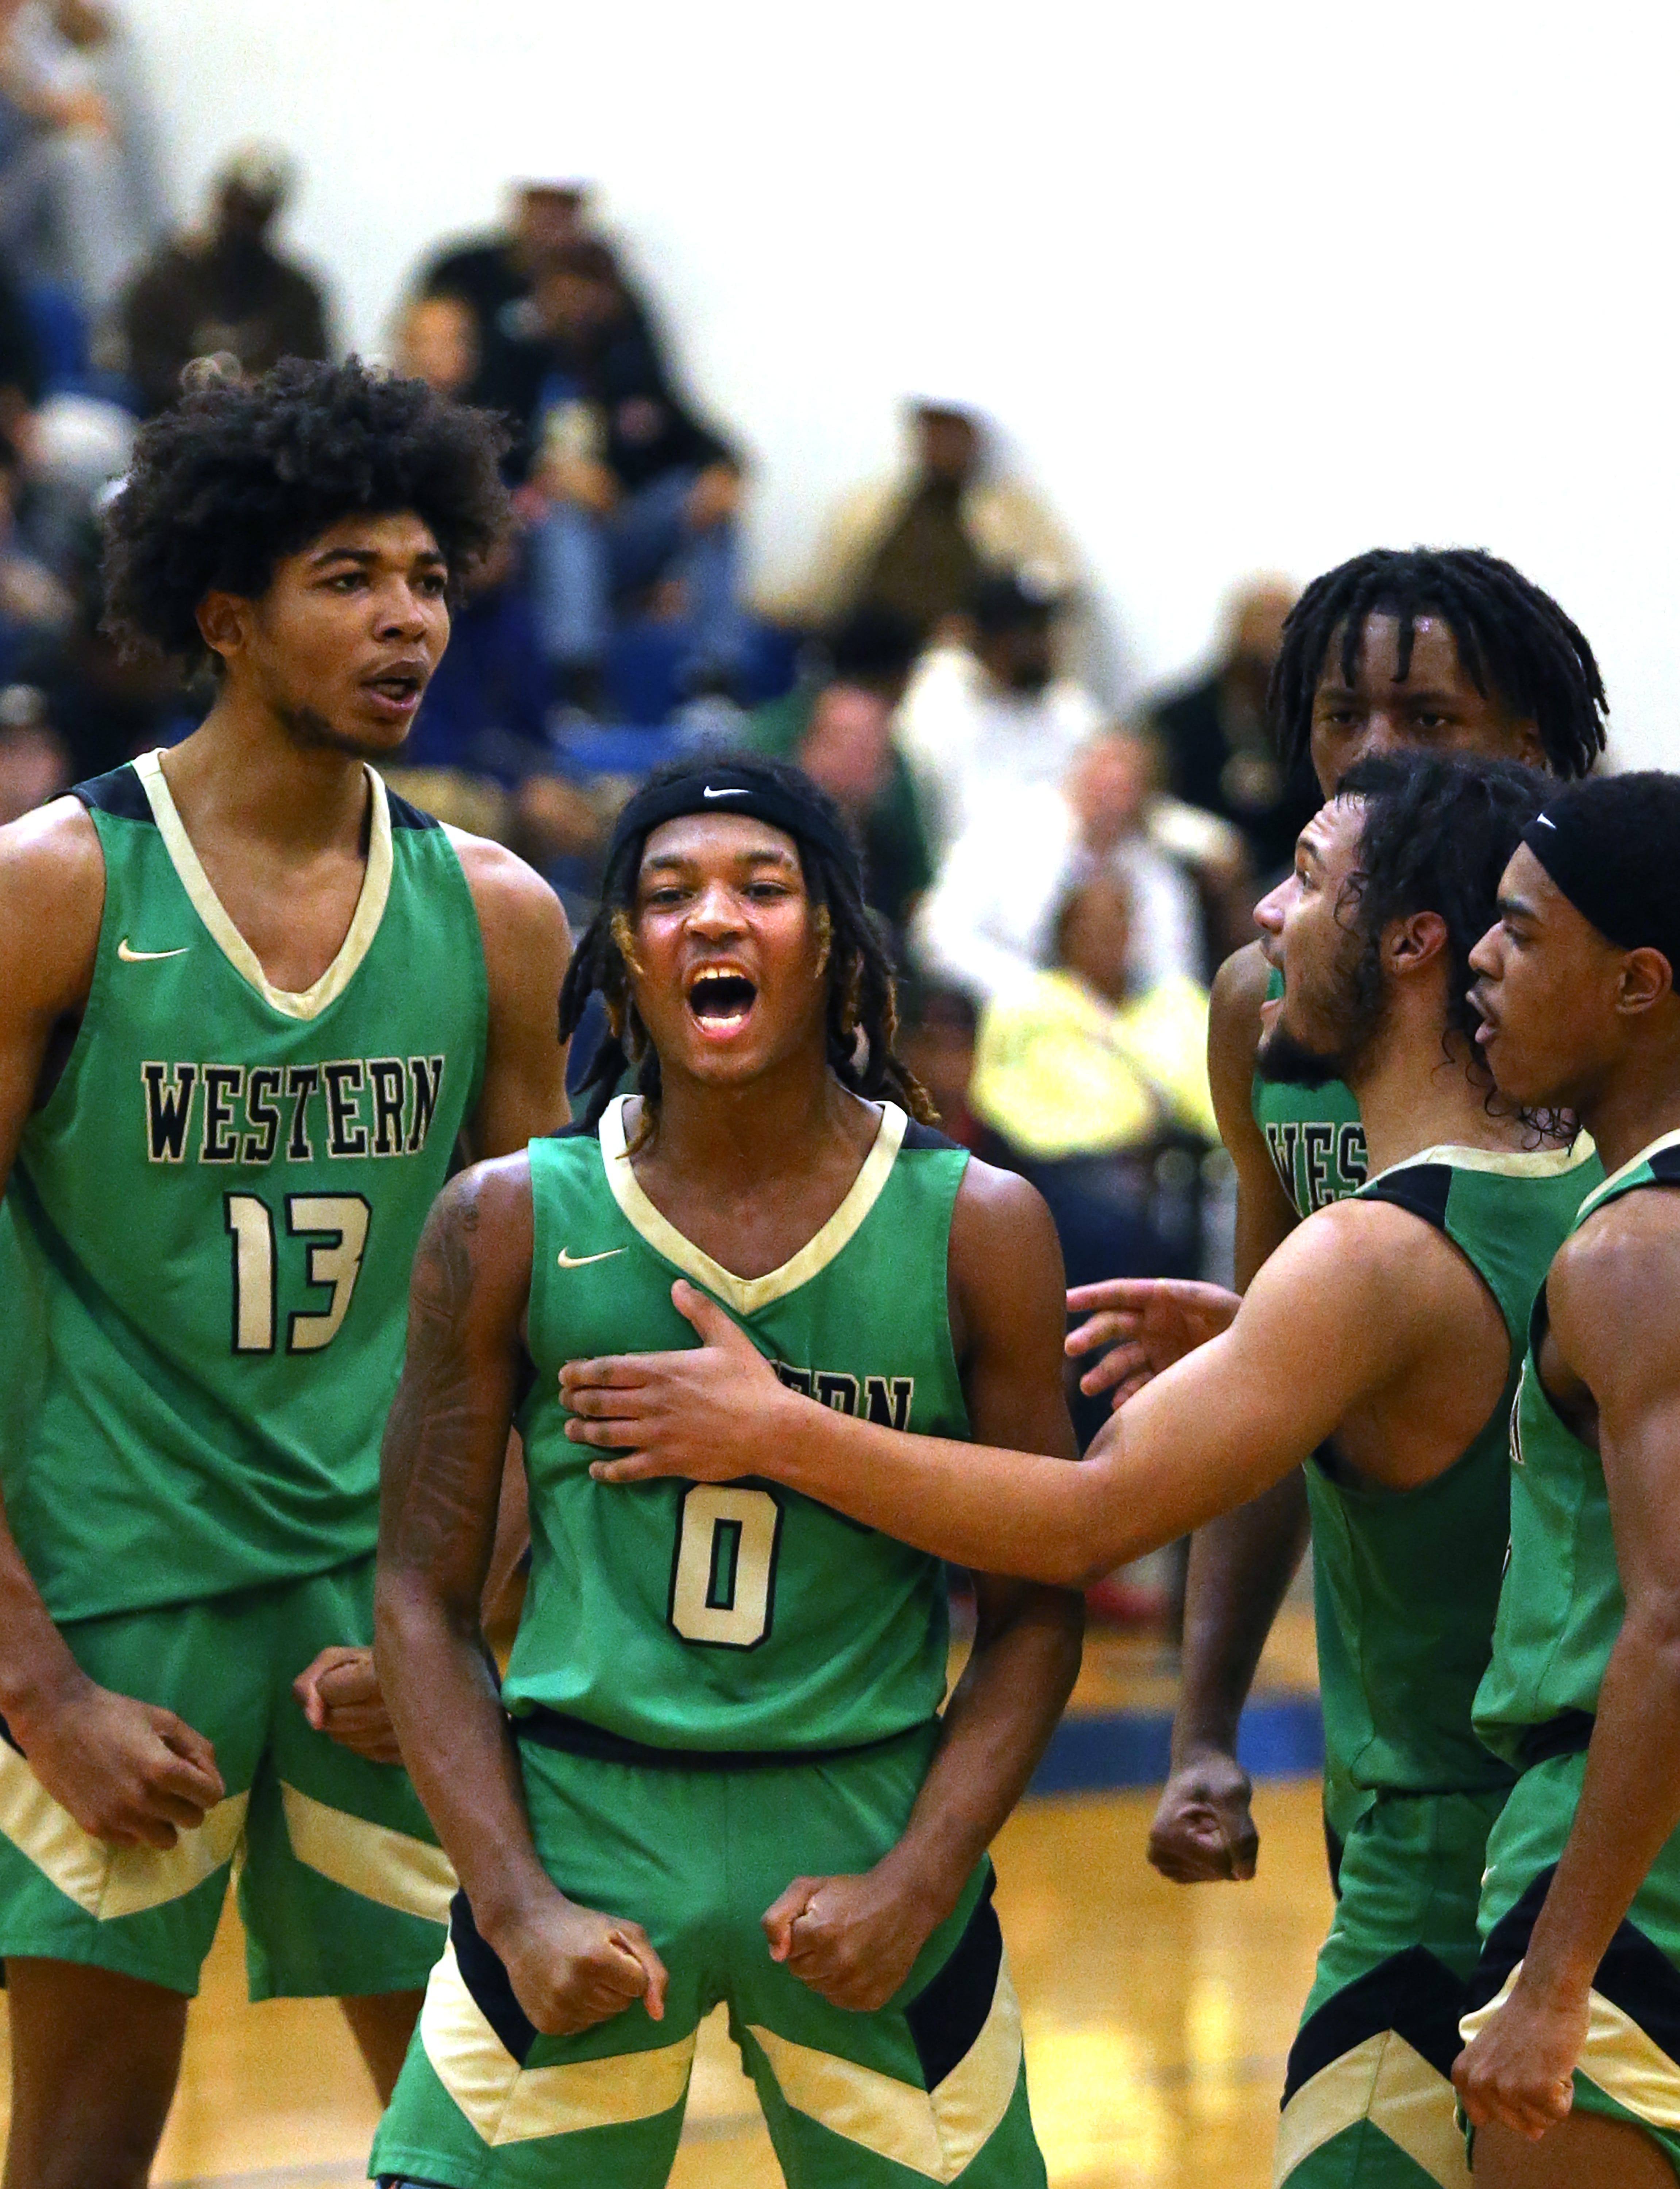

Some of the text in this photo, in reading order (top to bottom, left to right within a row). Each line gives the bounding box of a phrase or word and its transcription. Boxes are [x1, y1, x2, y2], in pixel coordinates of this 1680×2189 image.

[141, 1054, 445, 1165] WESTERN
[223, 1189, 372, 1355] 13
[666, 1481, 784, 1653] 0
